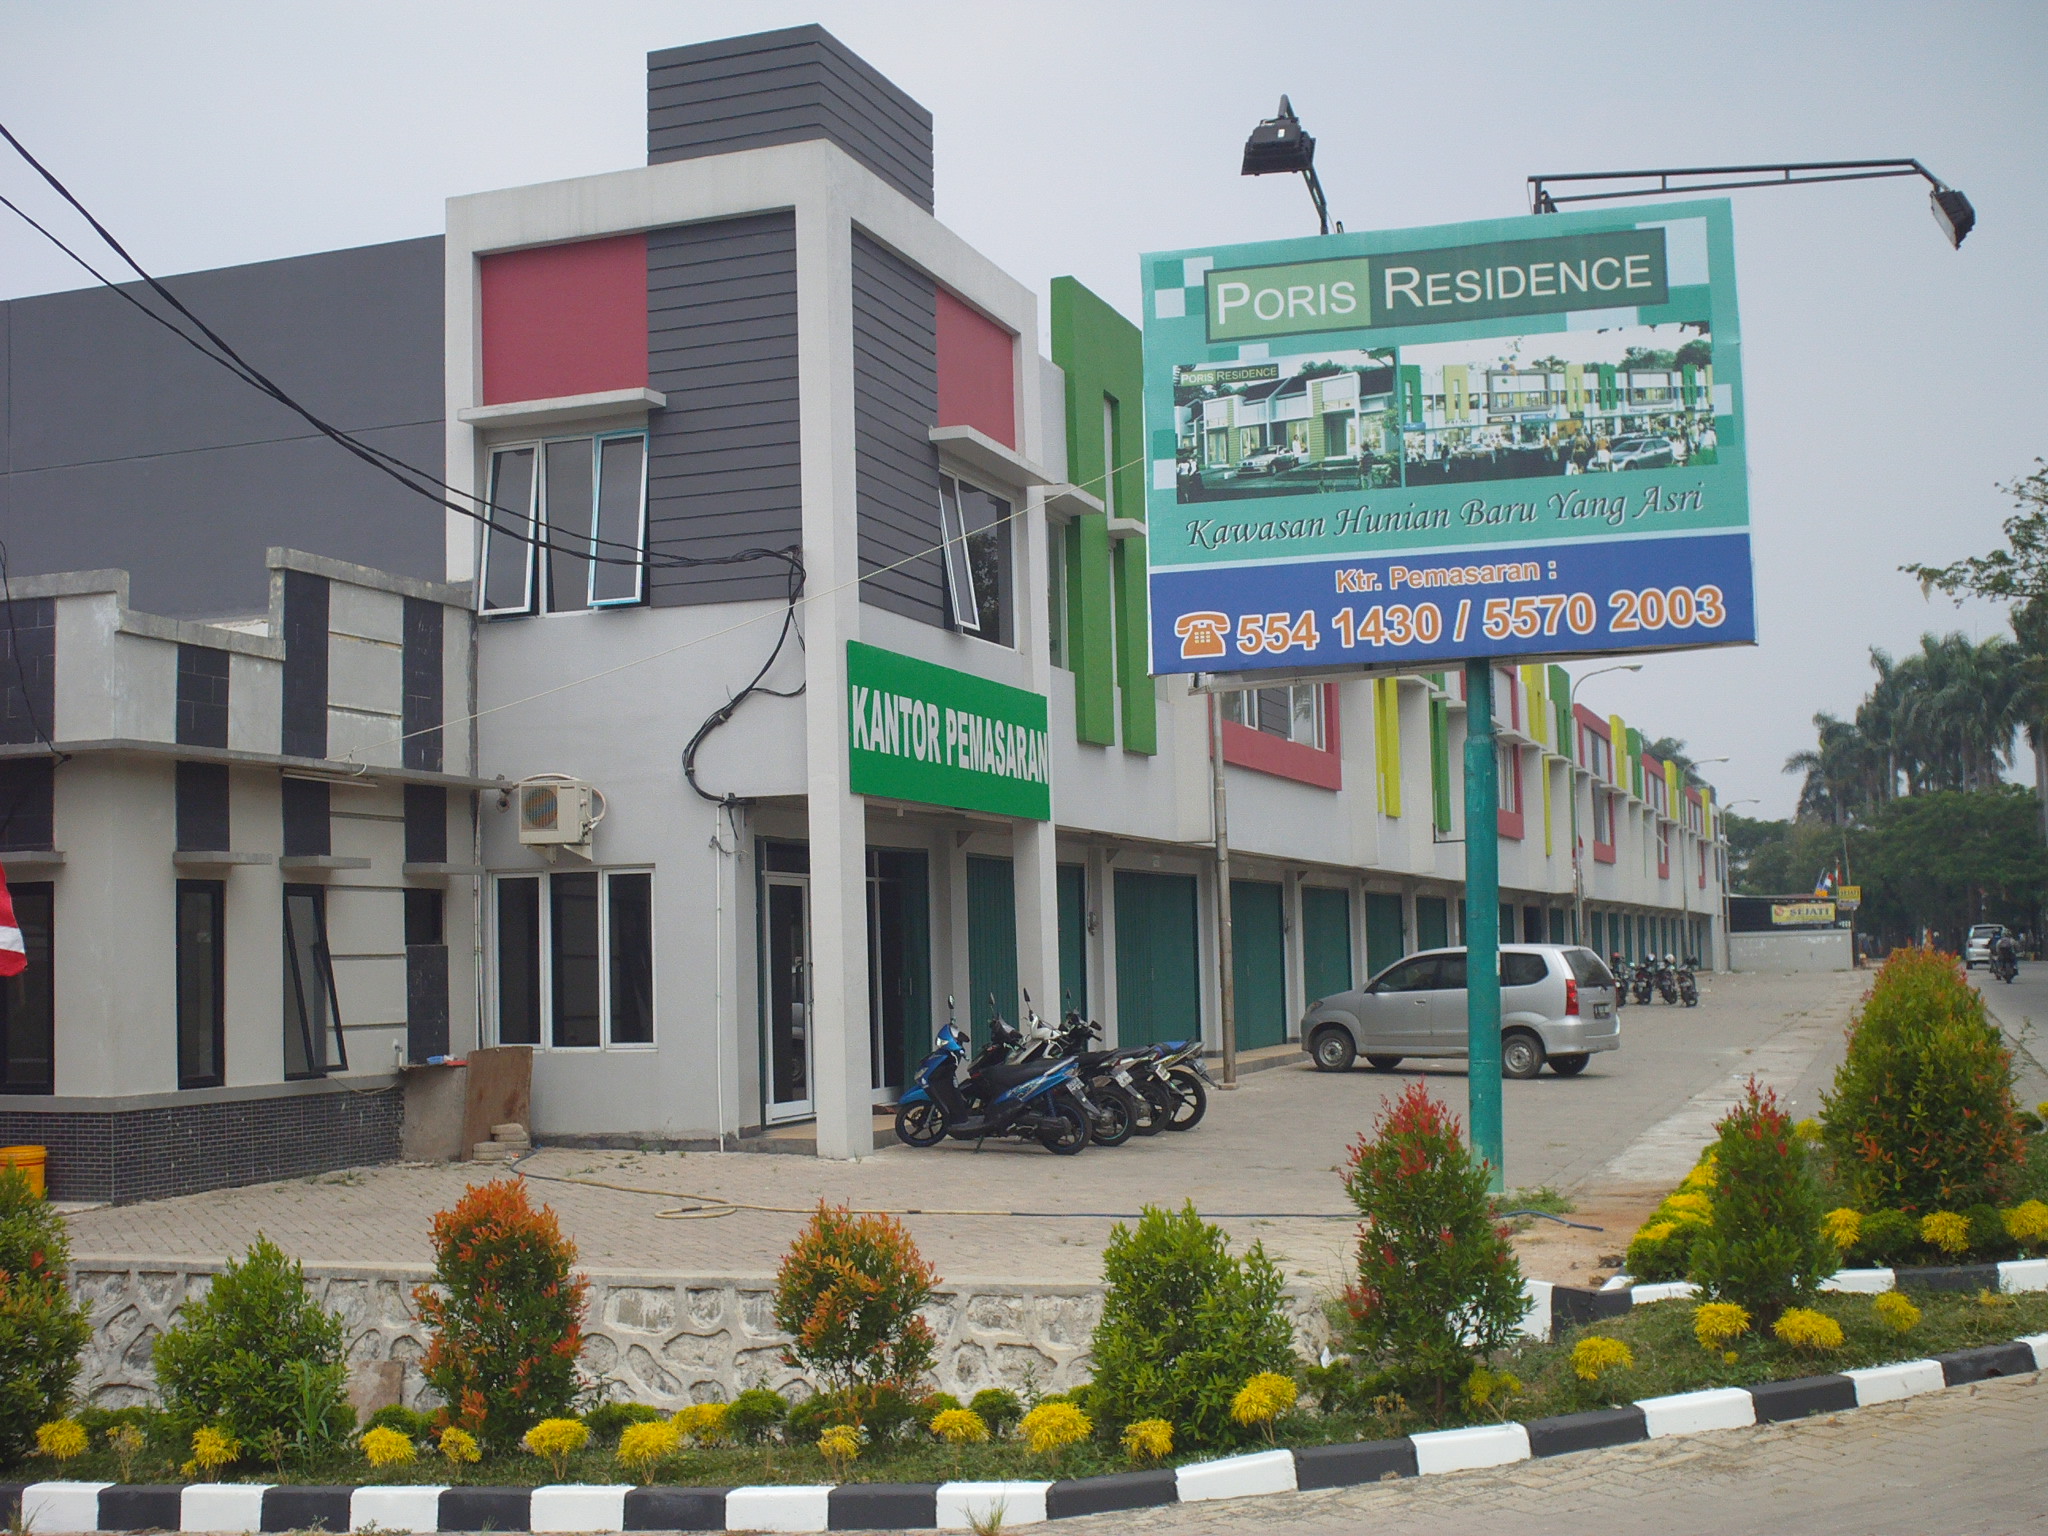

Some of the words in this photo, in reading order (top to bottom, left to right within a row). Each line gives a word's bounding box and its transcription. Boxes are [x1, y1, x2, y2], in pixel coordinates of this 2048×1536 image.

[1185, 515, 1327, 550] Kawasan
[1333, 502, 1451, 536] Hunian
[1460, 498, 1539, 526] Baru
[1547, 489, 1629, 526] Yang
[1632, 482, 1705, 518] Asri
[1335, 568, 1383, 593] Ktr.
[1389, 560, 1541, 590] Pemasaran
[1236, 609, 1320, 655] 554
[1332, 601, 1443, 648] 1430
[1482, 592, 1597, 640] 5570
[1609, 584, 1727, 633] 2003
[852, 684, 942, 764] KANTOR
[945, 707, 1049, 784] PEMASARAN
